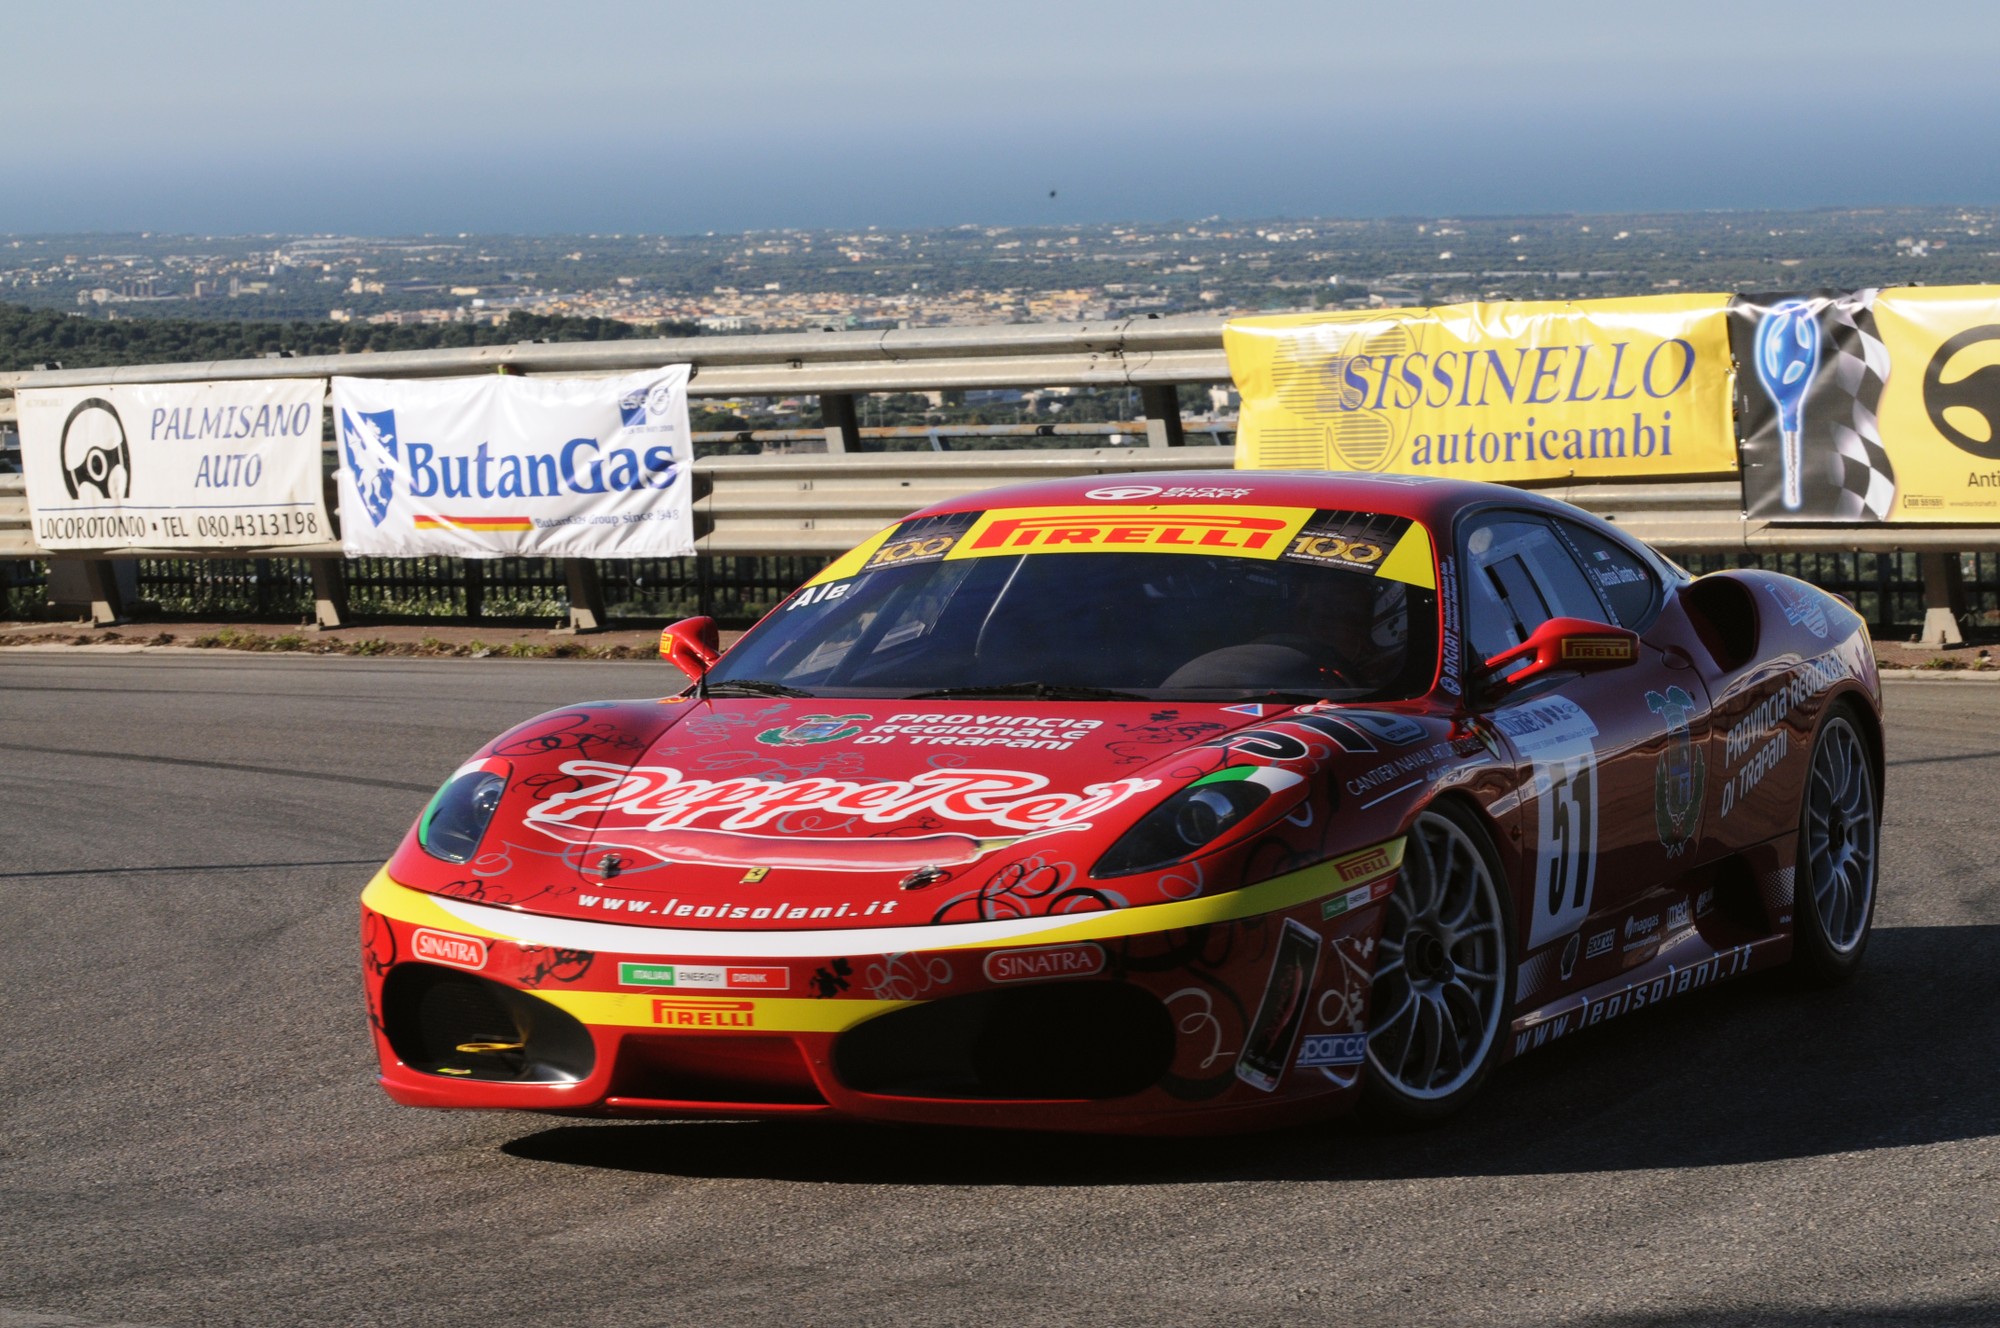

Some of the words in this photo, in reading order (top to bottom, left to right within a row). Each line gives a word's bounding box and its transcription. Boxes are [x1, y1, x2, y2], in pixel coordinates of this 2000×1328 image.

[1339, 338, 1695, 412] SISSINELLO
[150, 402, 312, 441] PALMISANO
[1411, 411, 1672, 466] autoricambi
[194, 453, 262, 488] AUTO
[405, 438, 678, 499] ButanGas
[1159, 491, 1251, 499] SHAFT
[1166, 487, 1255, 495] BLOCK
[39, 516, 146, 540] LOCOROTONDO
[161, 516, 188, 537] TEL
[198, 511, 318, 538] 080.4313198
[623, 511, 653, 522] since
[969, 514, 1287, 550] PIRELLI
[873, 536, 954, 565] 100
[1293, 536, 1384, 563] 100
[786, 582, 851, 611] Ale
[1565, 641, 1628, 657] PIRELLI
[853, 735, 894, 745] DI
[1346, 761, 1401, 796] CANTIERI
[1721, 781, 1737, 819] DI
[1549, 756, 1590, 916] 51
[1334, 848, 1391, 882] PIRELLI
[577, 893, 899, 920] www.leoisolani.it
[418, 934, 479, 963] SINATRA
[997, 949, 1094, 977] SINATRA
[633, 969, 672, 981] ITALIAN
[679, 972, 722, 983] ENERGY
[731, 973, 768, 983] DRINK
[652, 999, 755, 1027] PIRELLI
[1516, 944, 1752, 1057] www.leoisolani.it
